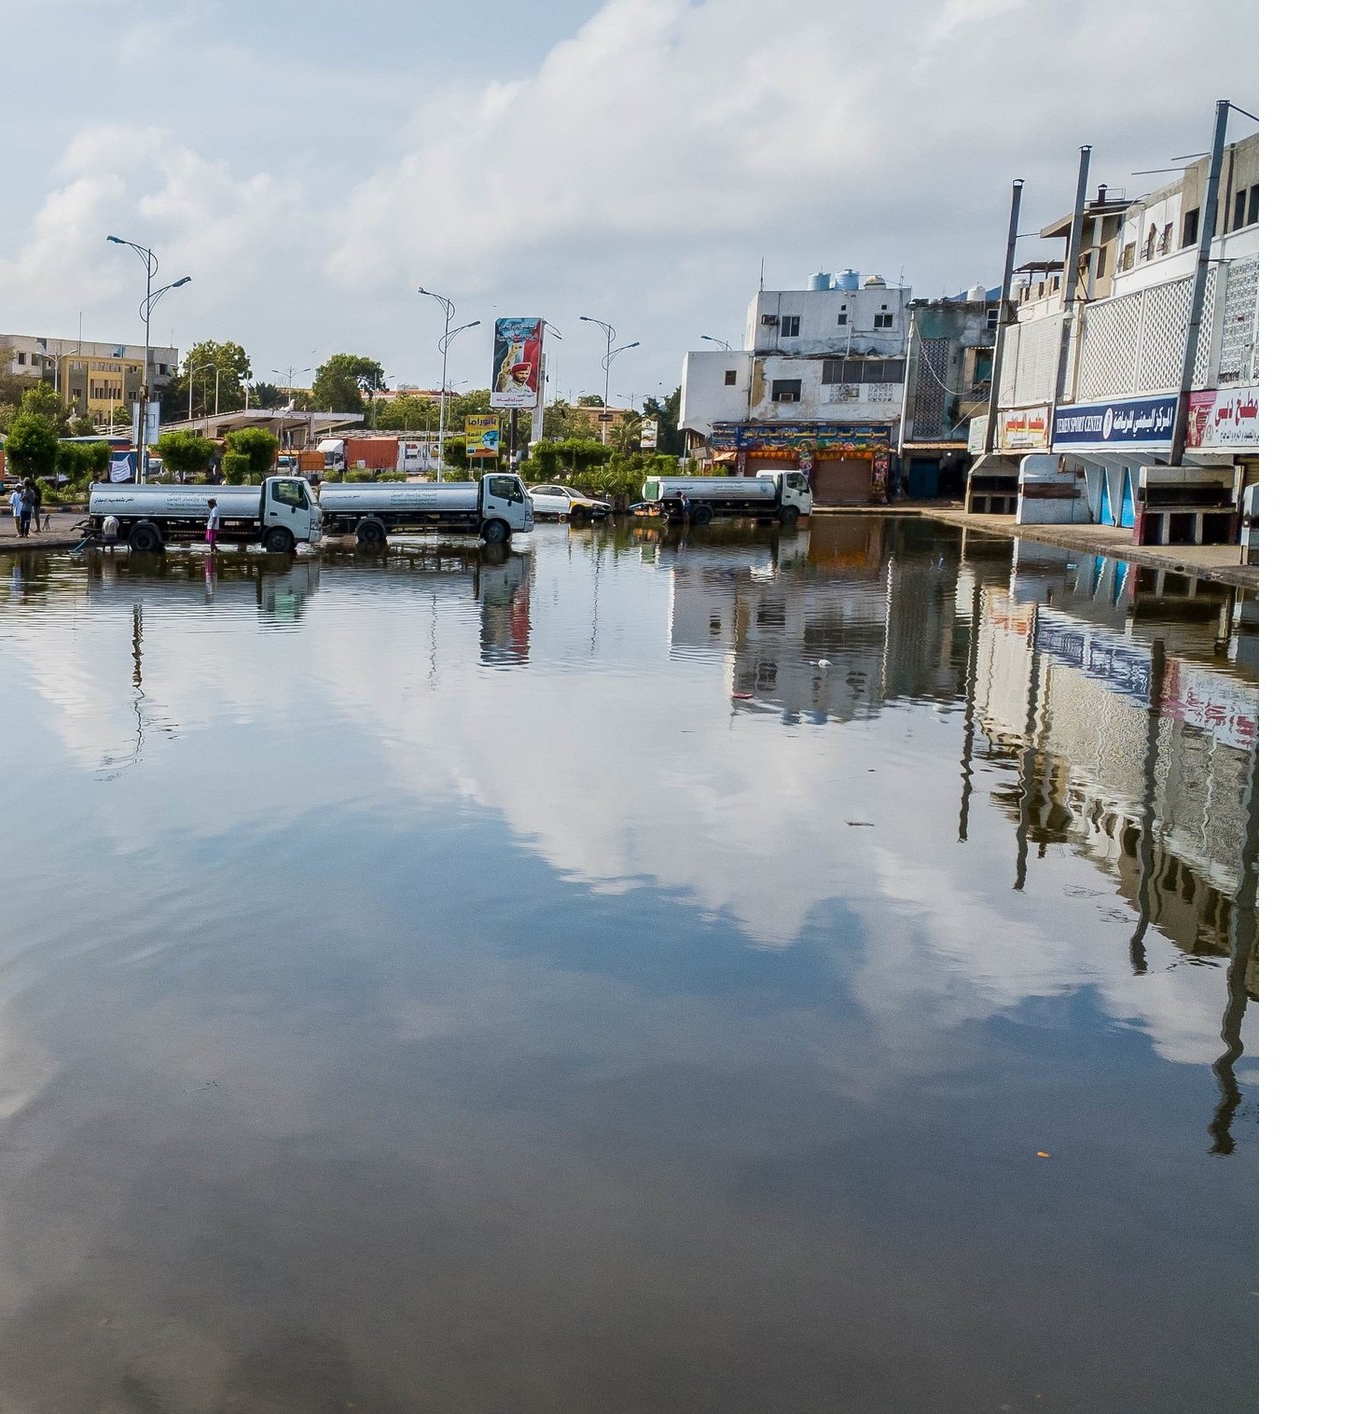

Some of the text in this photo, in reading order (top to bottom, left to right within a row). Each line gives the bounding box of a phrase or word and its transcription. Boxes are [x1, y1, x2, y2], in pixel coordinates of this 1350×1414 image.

[469, 417, 496, 425] بانوراما
[1153, 406, 1173, 433] المركز
[1235, 391, 1259, 426] مطبخ
[1084, 415, 1103, 432] CENTER
[1132, 408, 1156, 437] اليمني
